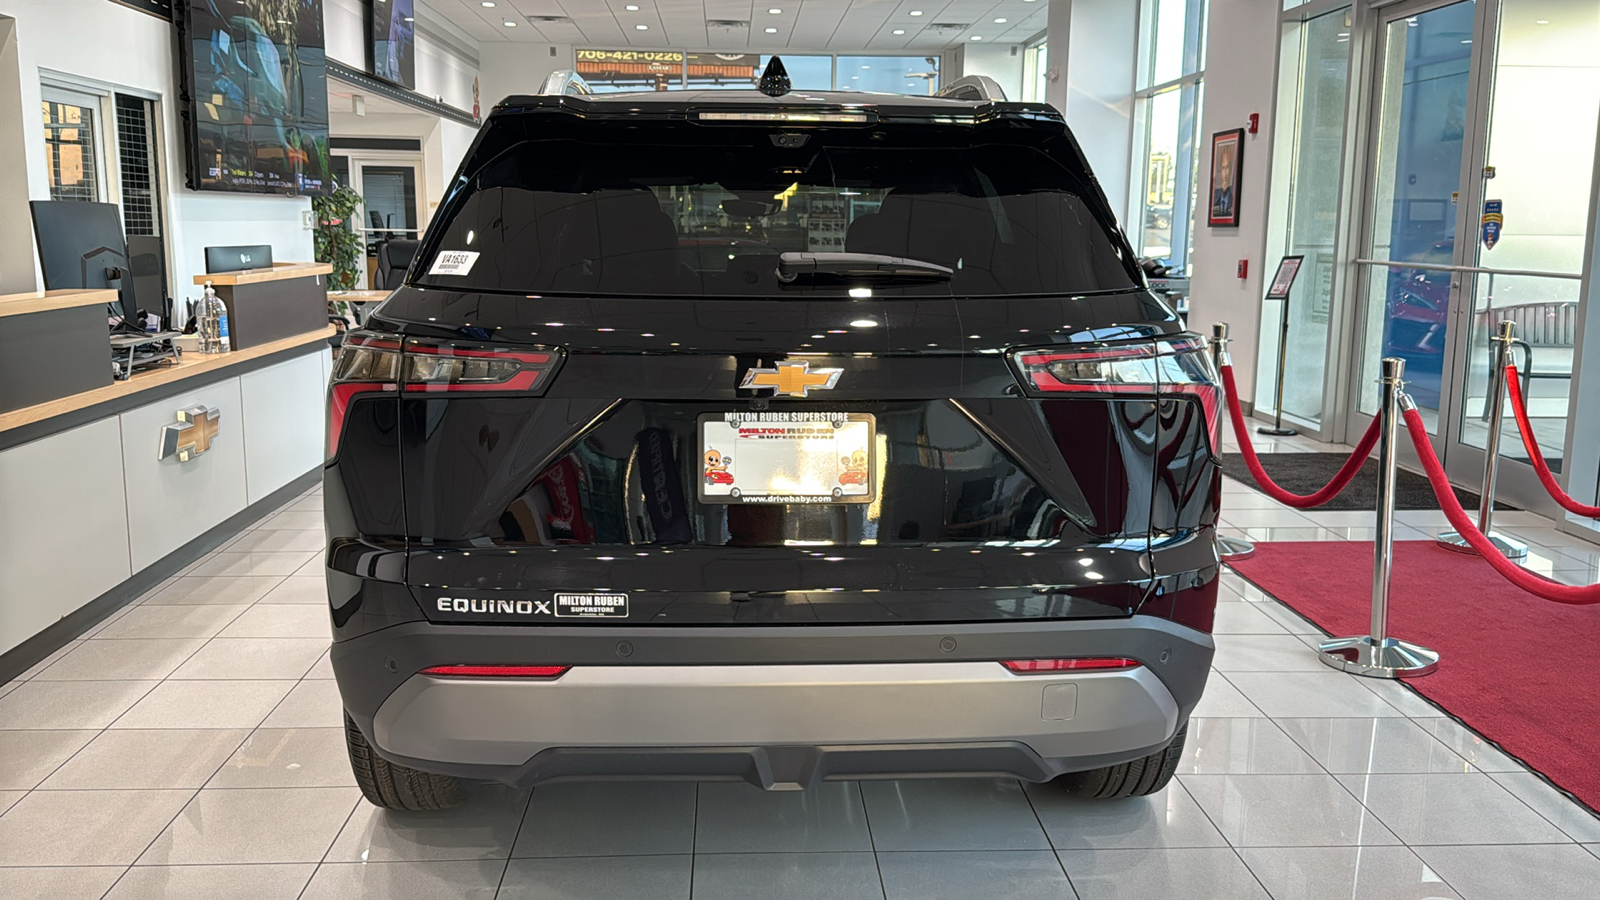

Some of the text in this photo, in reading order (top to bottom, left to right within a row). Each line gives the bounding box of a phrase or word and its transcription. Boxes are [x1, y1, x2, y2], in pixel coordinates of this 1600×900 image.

[576, 50, 683, 62] 706-421-0226
[441, 254, 469, 265] VA1633
[724, 411, 849, 422] MILTON RUBEN SUPERSTORE
[742, 495, 832, 504] www.drivebaby.com
[437, 597, 551, 615] EQUINOX
[559, 595, 625, 606] MILTON RUBEN
